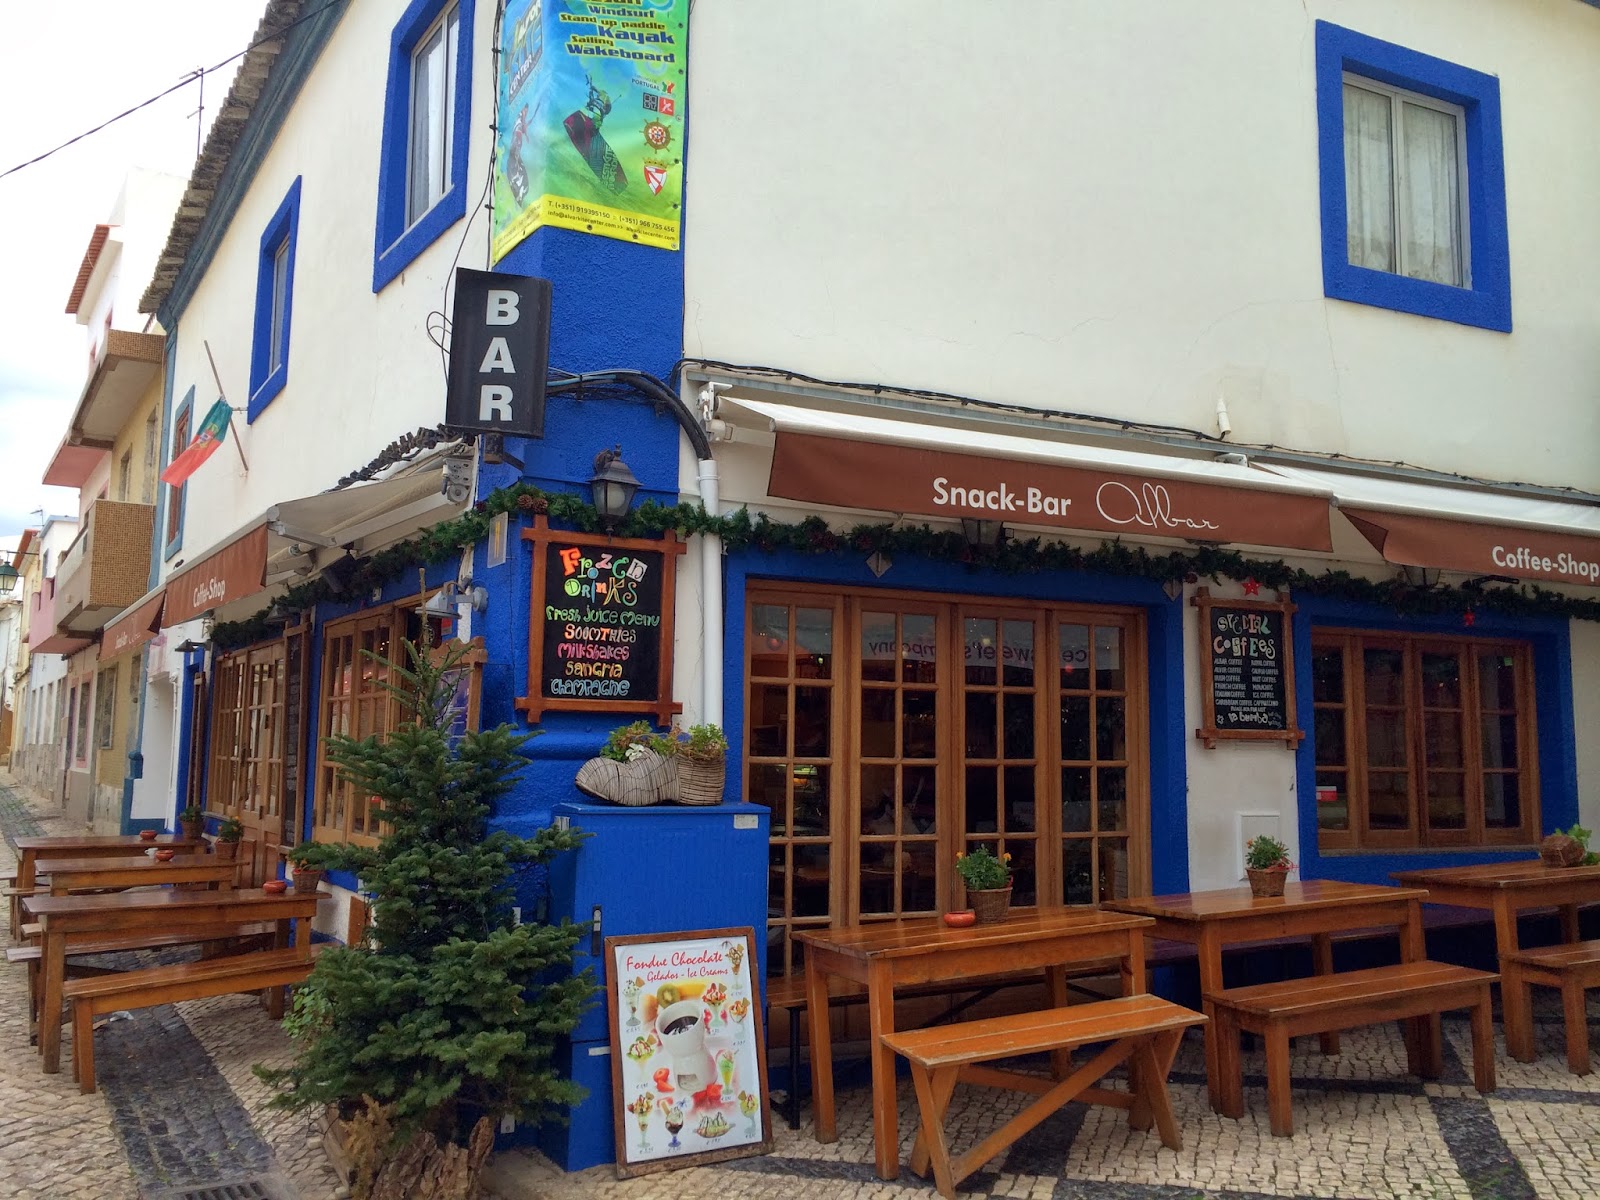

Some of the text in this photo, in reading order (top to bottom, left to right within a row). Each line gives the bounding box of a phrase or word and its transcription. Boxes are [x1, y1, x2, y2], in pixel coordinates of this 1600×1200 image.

[588, 5, 655, 18] Windsurf
[560, 14, 665, 30] Stand up paddle
[571, 35, 614, 47] Sailing
[598, 25, 675, 45] Kayak
[566, 43, 675, 63] Wakeboard
[631, 78, 661, 91] PORTUGAL
[479, 289, 520, 422] BAR
[933, 477, 1072, 516] Snack-Bar
[1492, 545, 1600, 582] Coffee-Shop
[626, 950, 723, 971] Fondue Chocolate
[647, 970, 679, 982] Gelados
[687, 968, 697, 978] Ice
[699, 966, 729, 977] Creams
